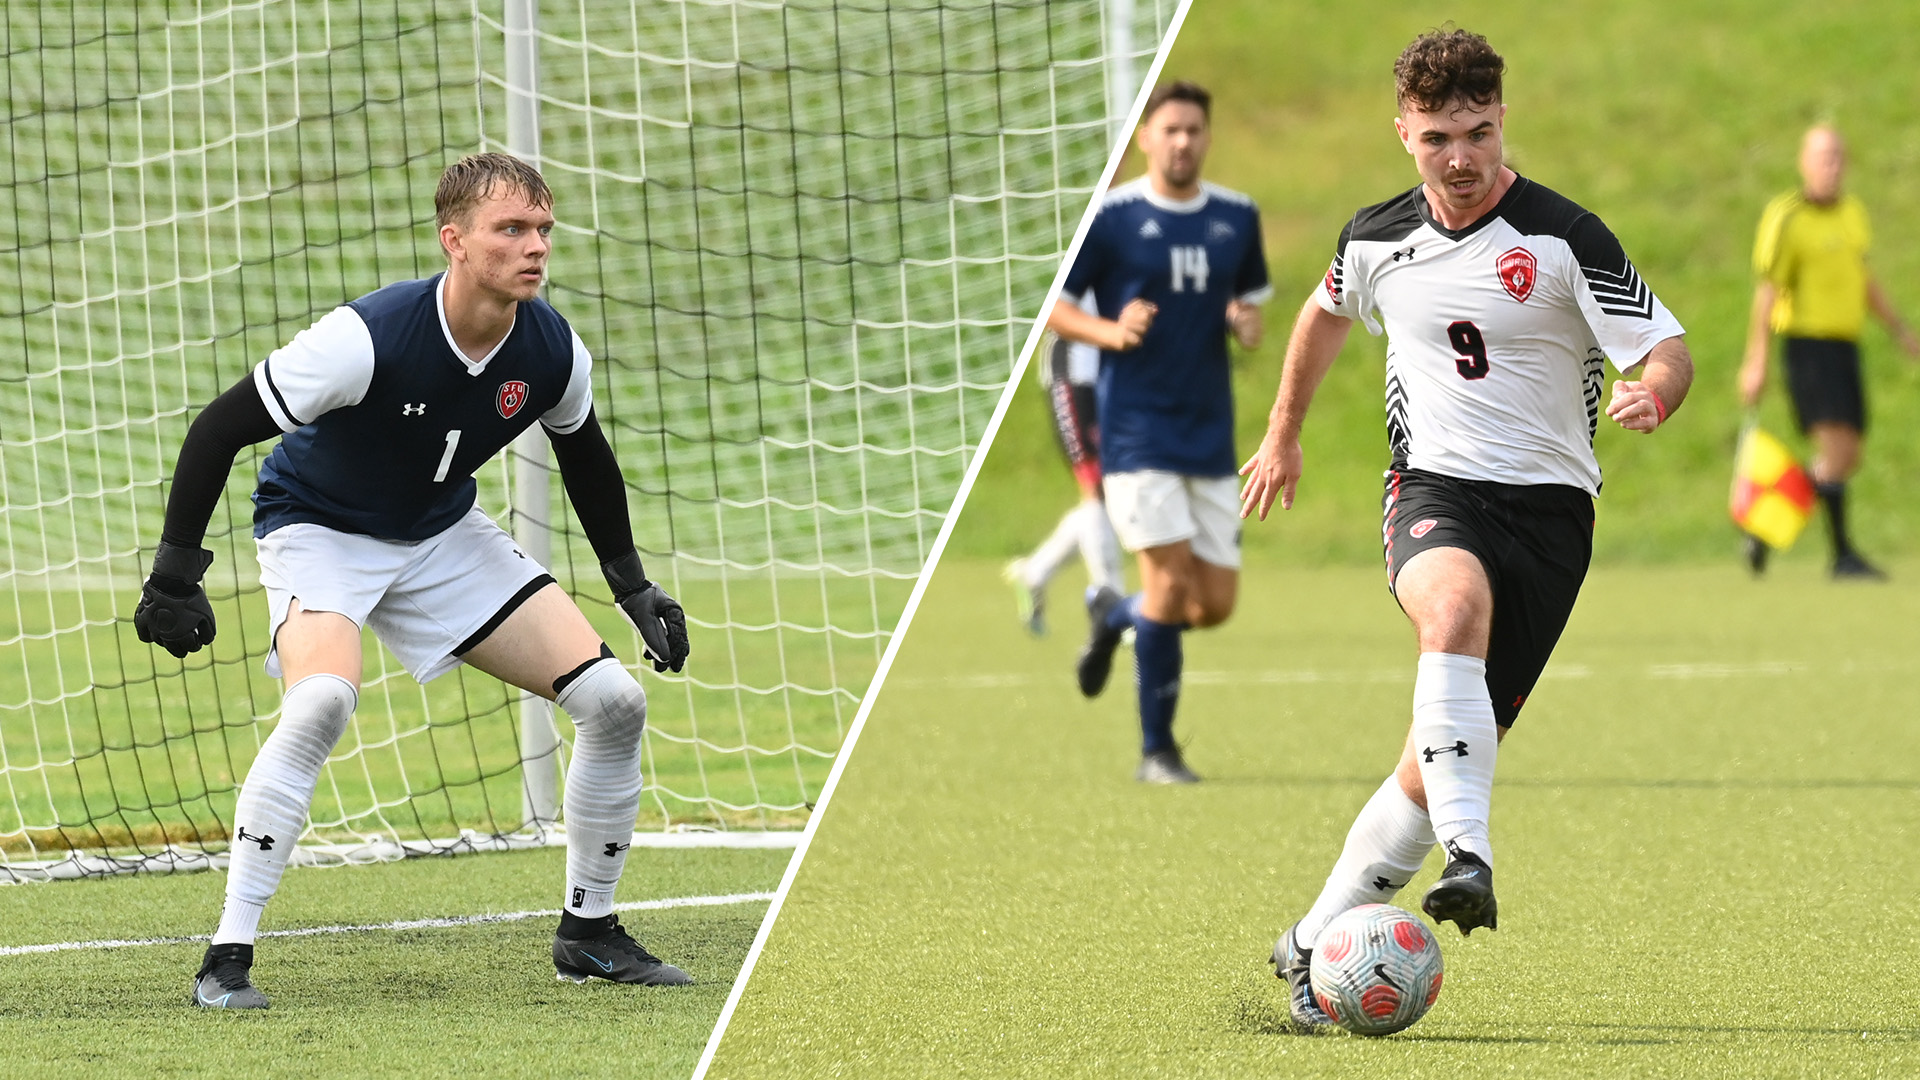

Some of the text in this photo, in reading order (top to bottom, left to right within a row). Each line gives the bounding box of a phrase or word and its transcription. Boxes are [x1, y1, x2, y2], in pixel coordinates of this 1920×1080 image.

[1169, 245, 1210, 293] 14
[1446, 320, 1491, 381] 9
[503, 383, 523, 393] SFU
[432, 429, 462, 482] 1
